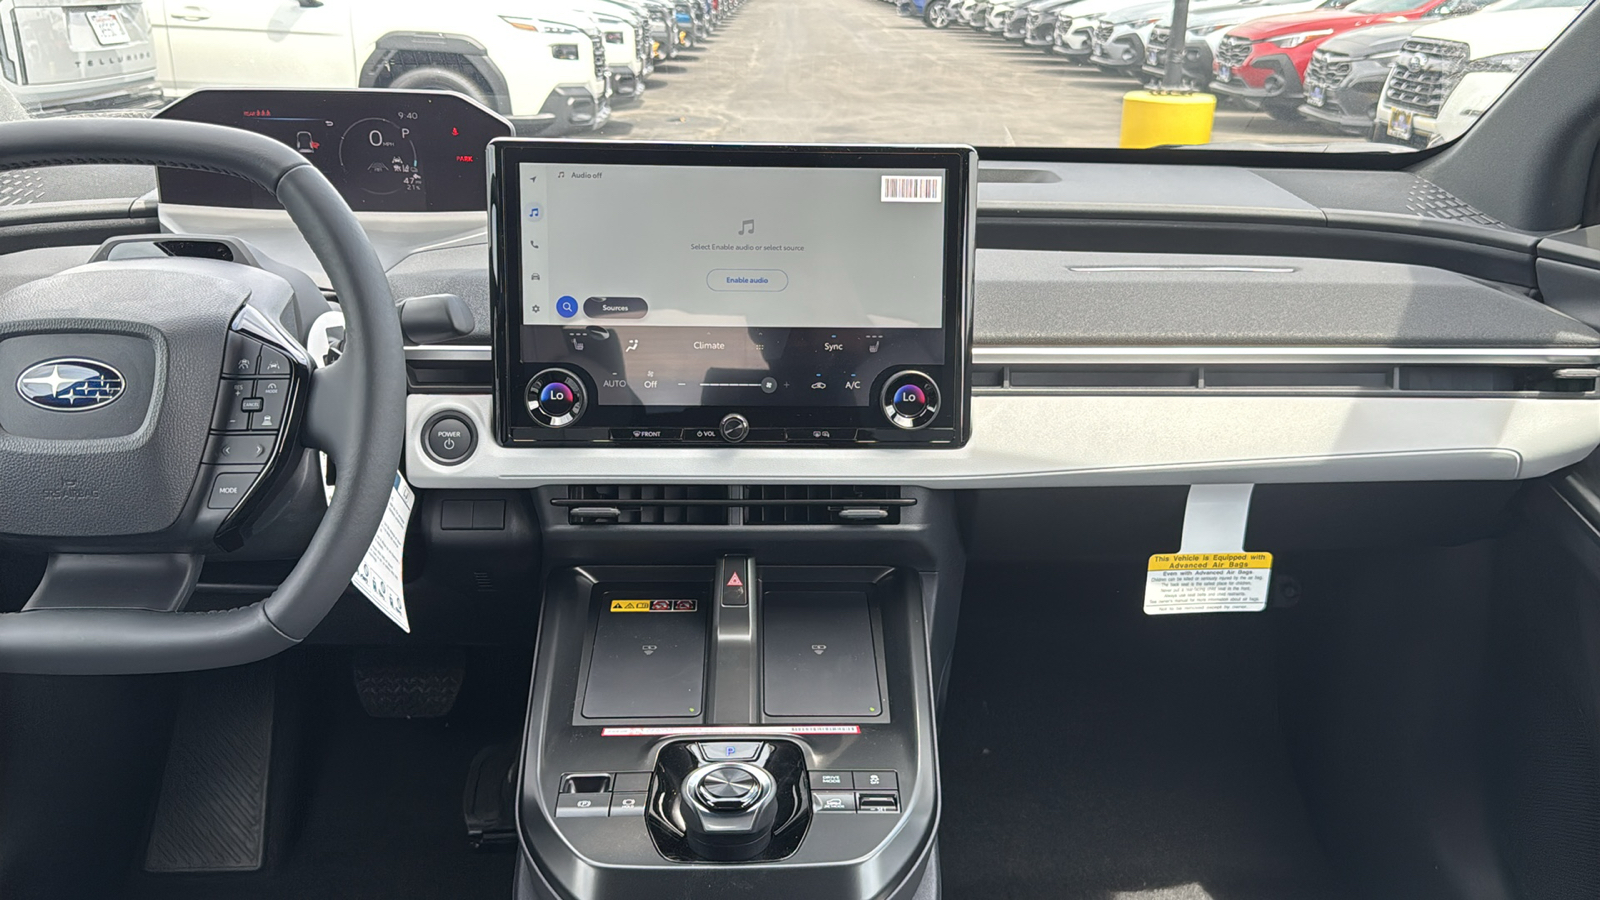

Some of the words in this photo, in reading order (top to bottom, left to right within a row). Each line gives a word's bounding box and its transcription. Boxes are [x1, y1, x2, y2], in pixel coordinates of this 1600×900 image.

[75, 52, 150, 67] TELLURIDE
[369, 130, 382, 146] 0
[402, 128, 410, 138] P
[824, 343, 843, 352] Sync
[550, 390, 564, 400] Lo
[903, 392, 916, 402] Lo
[726, 747, 735, 756] P
